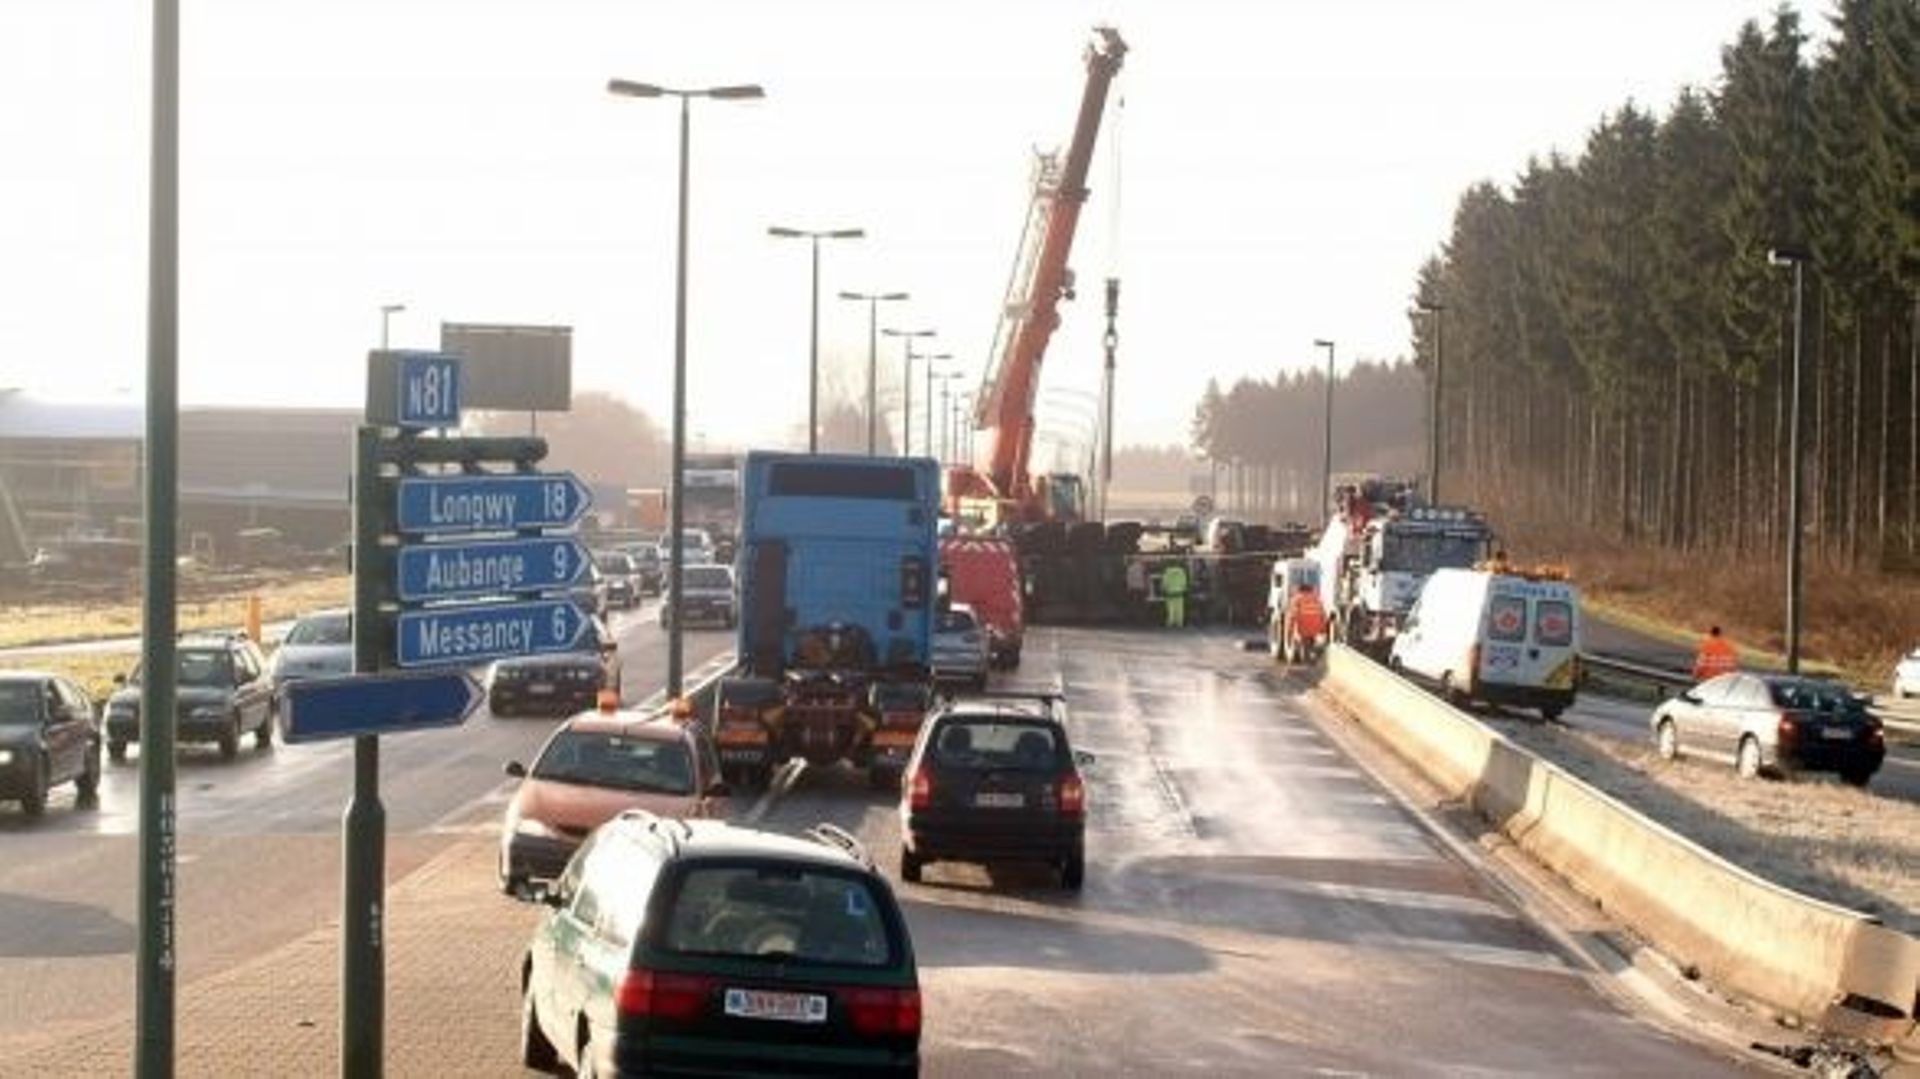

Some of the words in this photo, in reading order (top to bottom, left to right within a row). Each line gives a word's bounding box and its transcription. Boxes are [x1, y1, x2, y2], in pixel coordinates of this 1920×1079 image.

[408, 364, 452, 417] N81
[429, 484, 517, 530] Longwy
[543, 482, 567, 519] 18
[427, 549, 525, 591] Aubange
[553, 544, 568, 579] 9
[419, 618, 534, 656] Messancy
[553, 606, 568, 642] 6
